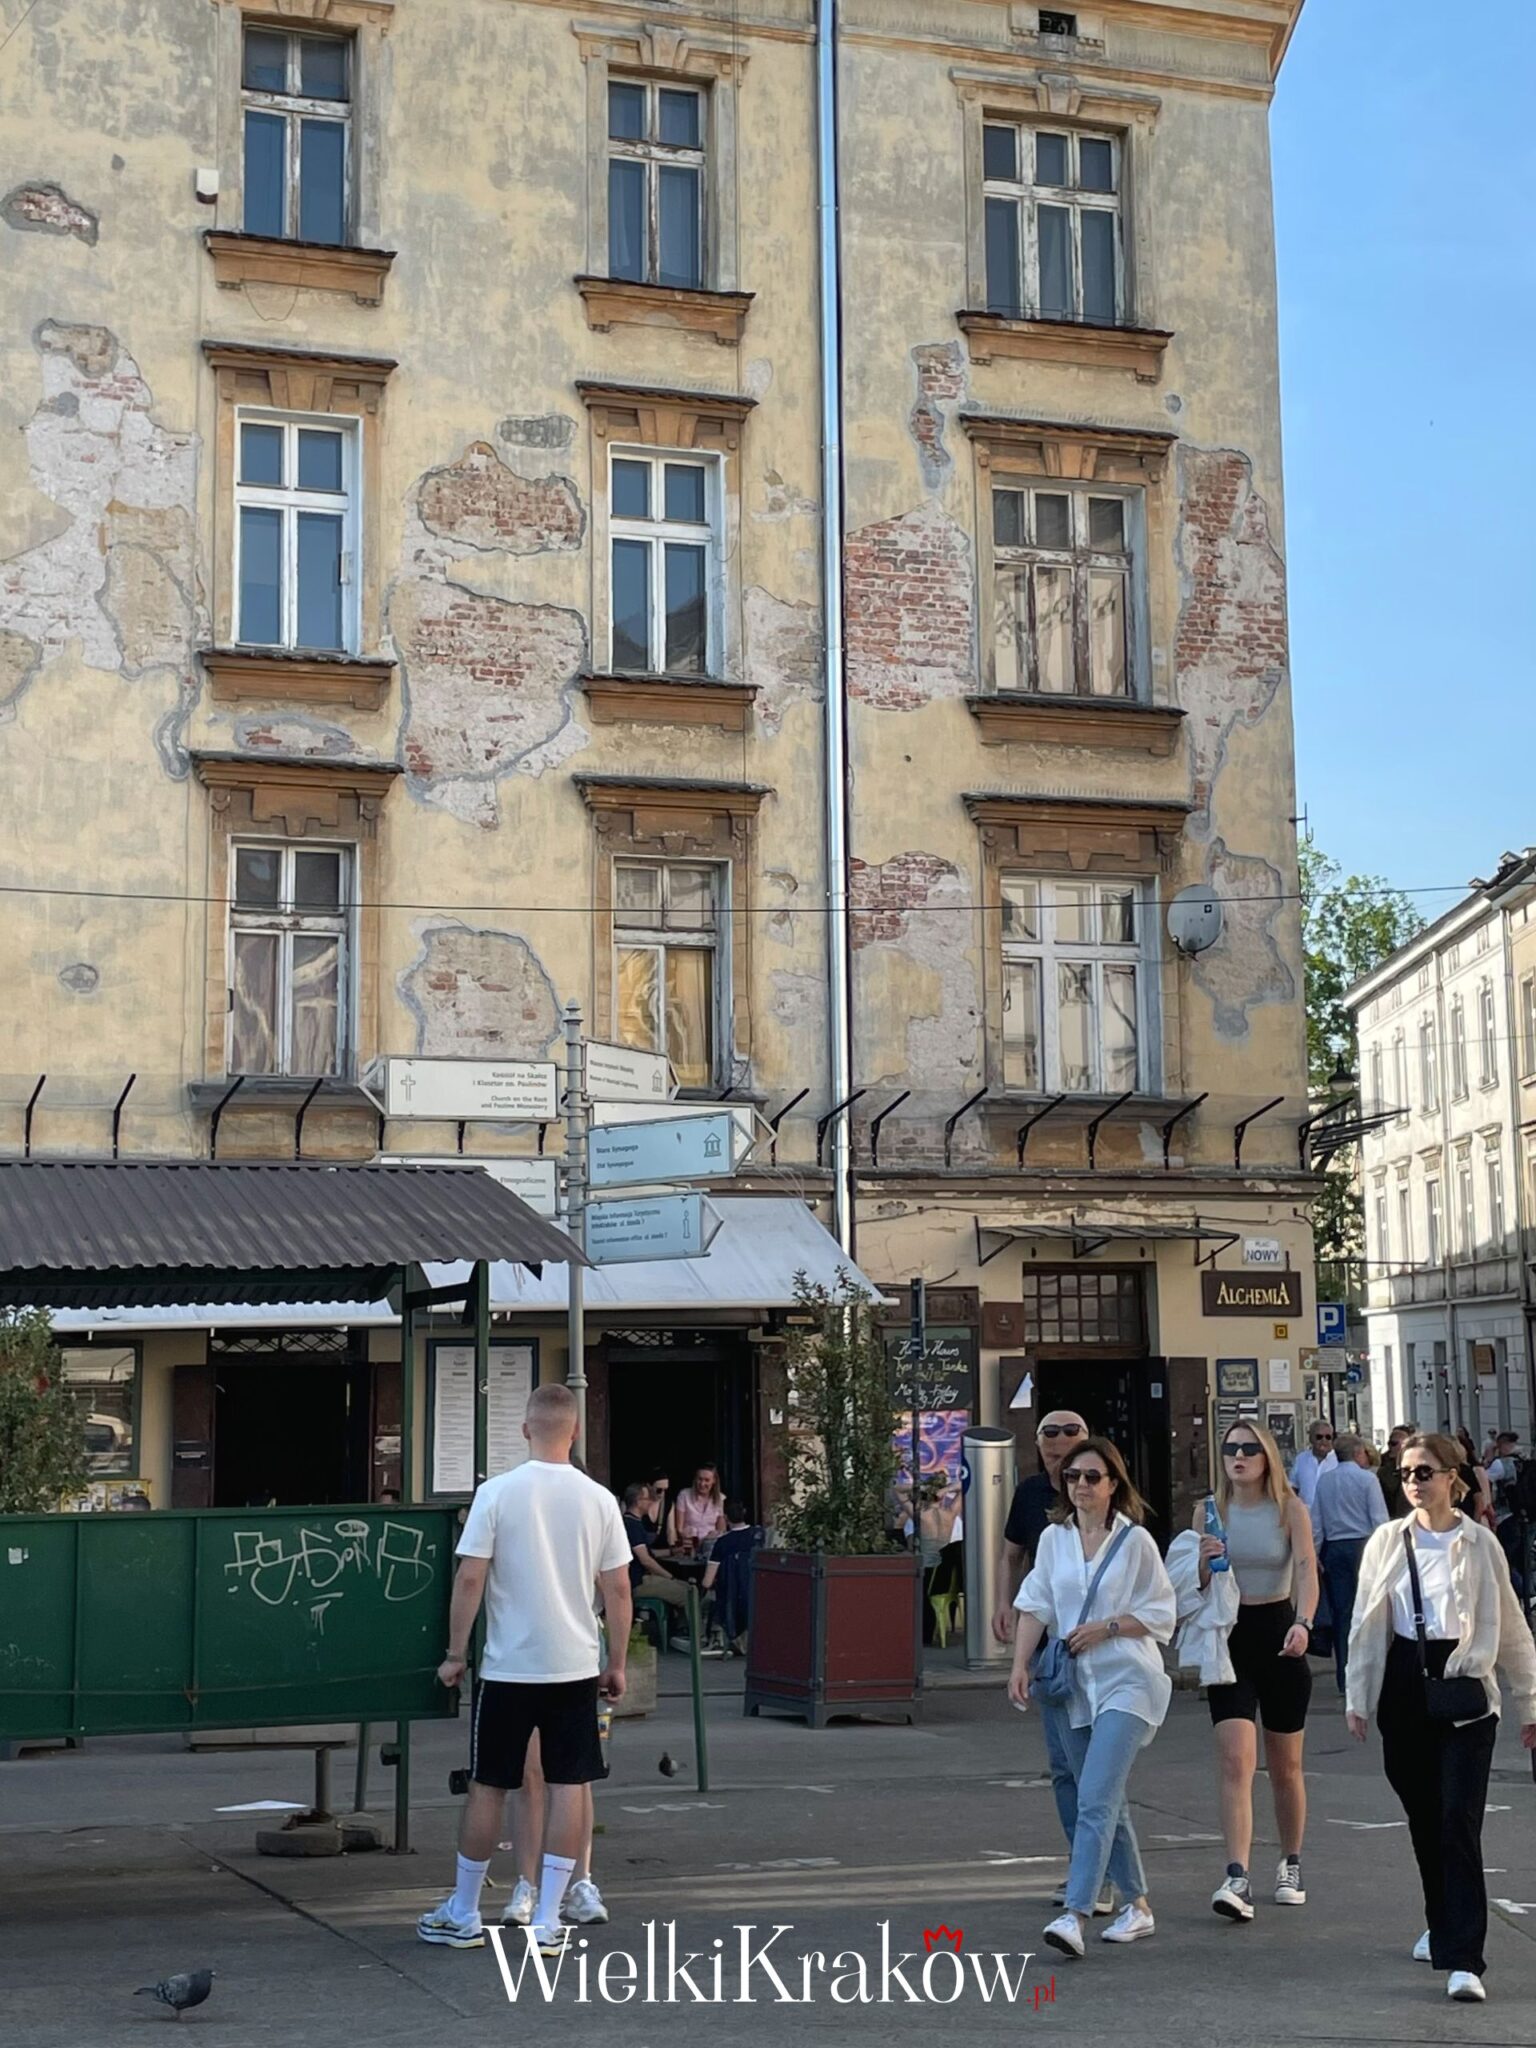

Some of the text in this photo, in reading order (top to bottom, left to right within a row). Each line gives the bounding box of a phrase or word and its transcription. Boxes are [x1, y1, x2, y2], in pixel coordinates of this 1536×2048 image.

[1247, 1250, 1278, 1261] NOWY
[1216, 1281, 1291, 1305] ALCHEMIA
[1319, 1307, 1339, 1334] P
